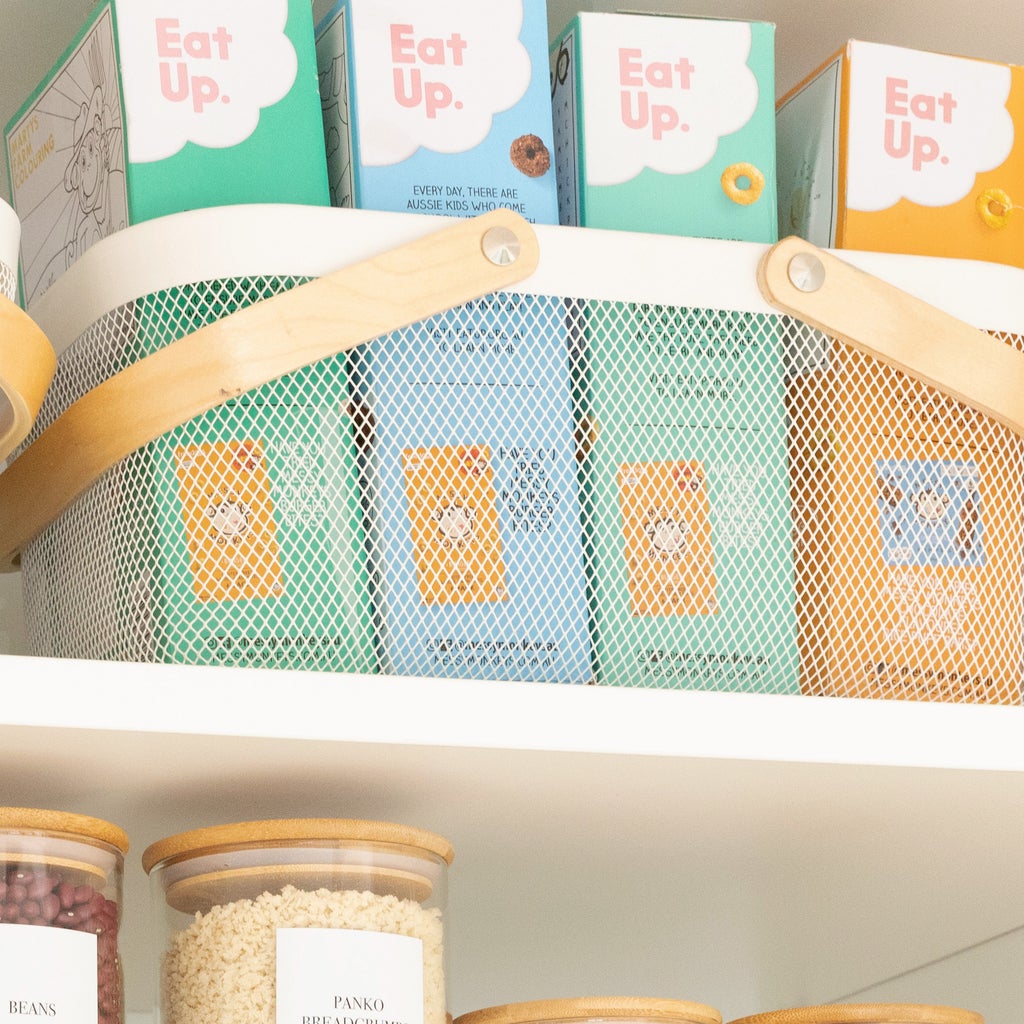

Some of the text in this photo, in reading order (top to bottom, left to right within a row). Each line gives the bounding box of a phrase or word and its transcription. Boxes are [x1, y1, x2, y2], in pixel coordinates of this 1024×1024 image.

[155, 18, 233, 60] Eat
[389, 23, 467, 66] Eat
[159, 62, 231, 113] Up.
[618, 48, 695, 90] Eat
[393, 68, 464, 119] Up.
[885, 77, 957, 124] Eat
[620, 91, 690, 140] Up.
[884, 120, 950, 171] Up.
[407, 199, 443, 210] AUSSIE
[446, 200, 469, 211] KIDS
[471, 201, 496, 212] WHO
[413, 185, 518, 199] EVERY DAY, THERE ARE
[9, 1000, 57, 1017] BEANS
[334, 995, 385, 1012] PANKO
